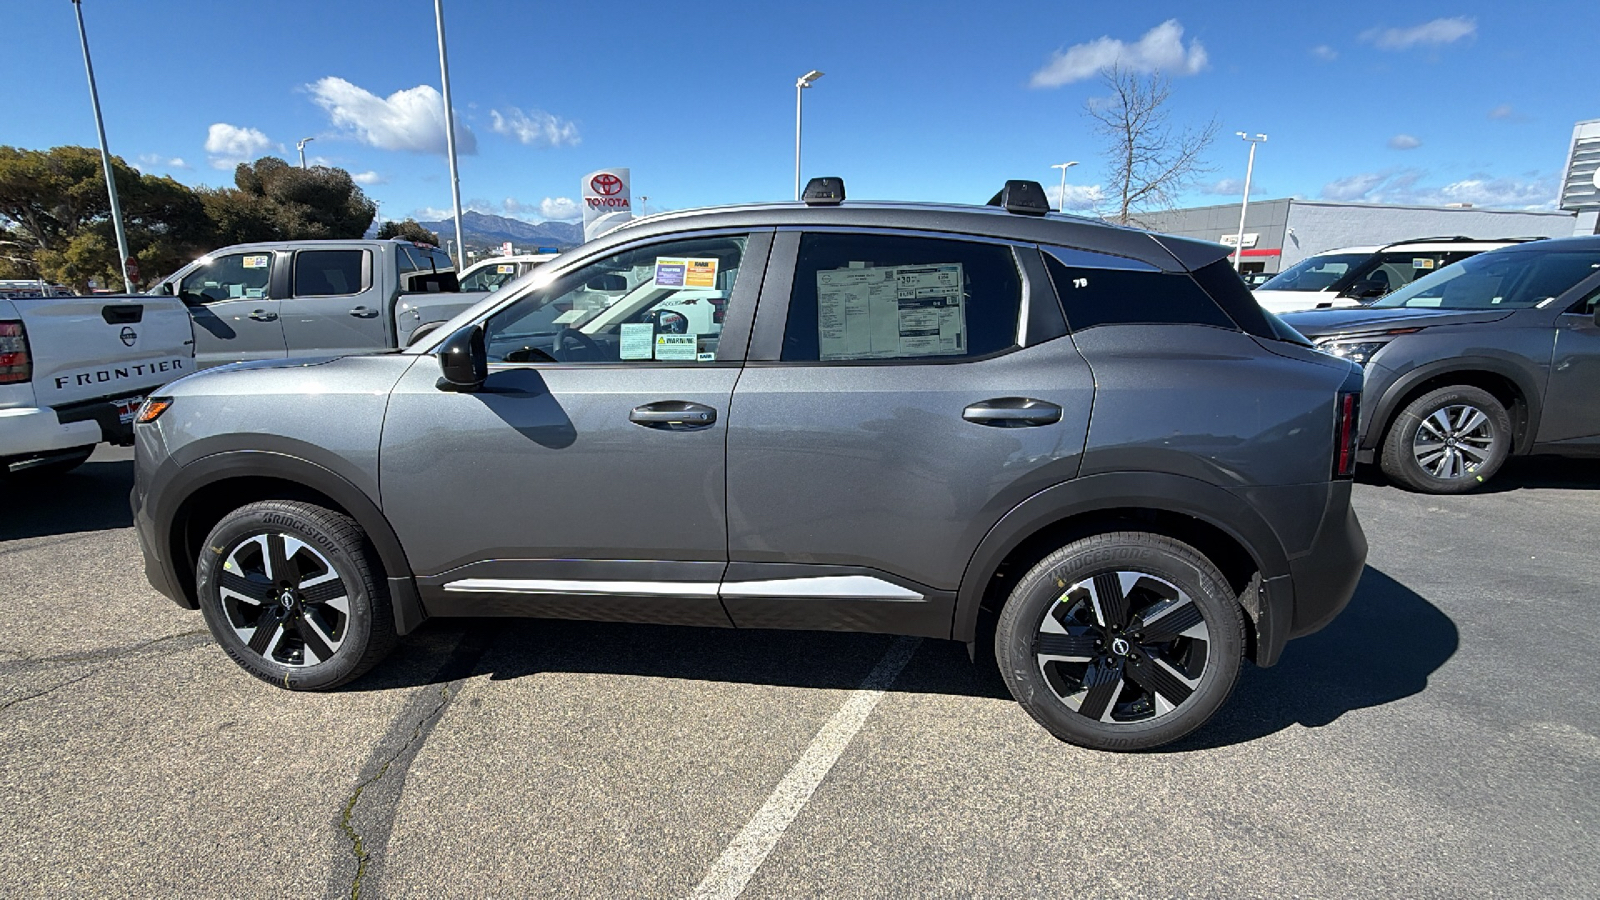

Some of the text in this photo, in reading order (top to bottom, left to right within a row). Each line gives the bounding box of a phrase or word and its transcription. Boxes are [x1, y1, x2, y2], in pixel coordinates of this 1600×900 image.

[585, 198, 629, 207] TOYOTA
[55, 359, 183, 389] FRONTIER
[262, 512, 341, 557] BRIDGESTONE
[1048, 547, 1152, 583] BRIDGESTONE
